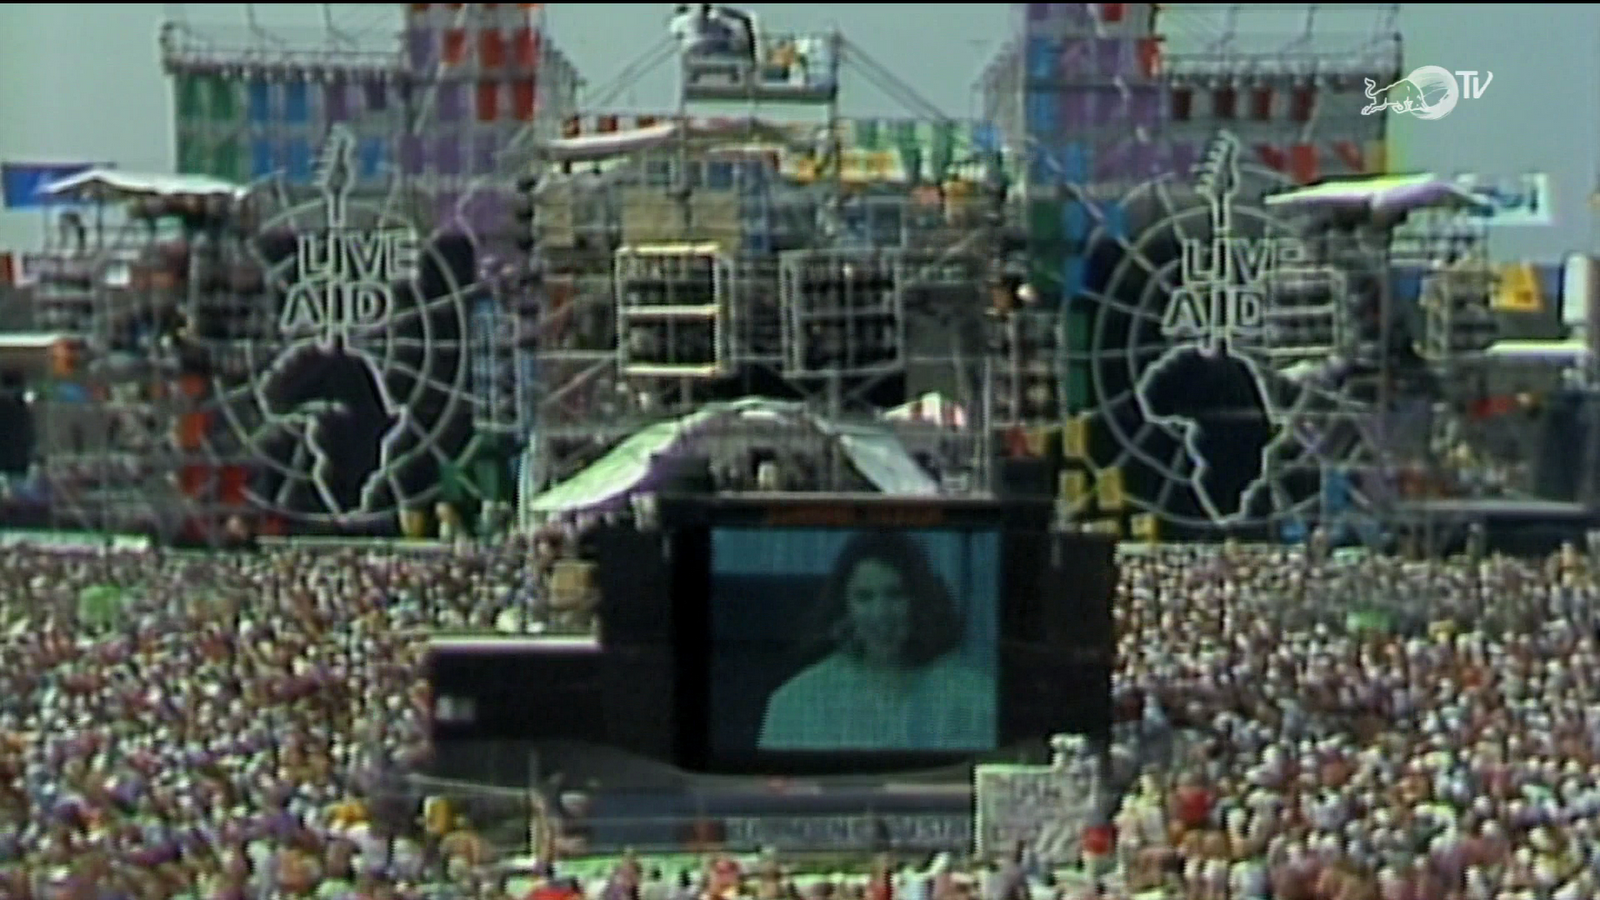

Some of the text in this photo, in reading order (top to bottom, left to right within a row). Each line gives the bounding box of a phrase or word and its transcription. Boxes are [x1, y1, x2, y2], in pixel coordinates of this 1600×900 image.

[298, 228, 418, 281] LIVE
[279, 279, 394, 334] AID
[1160, 286, 1272, 336] AID
